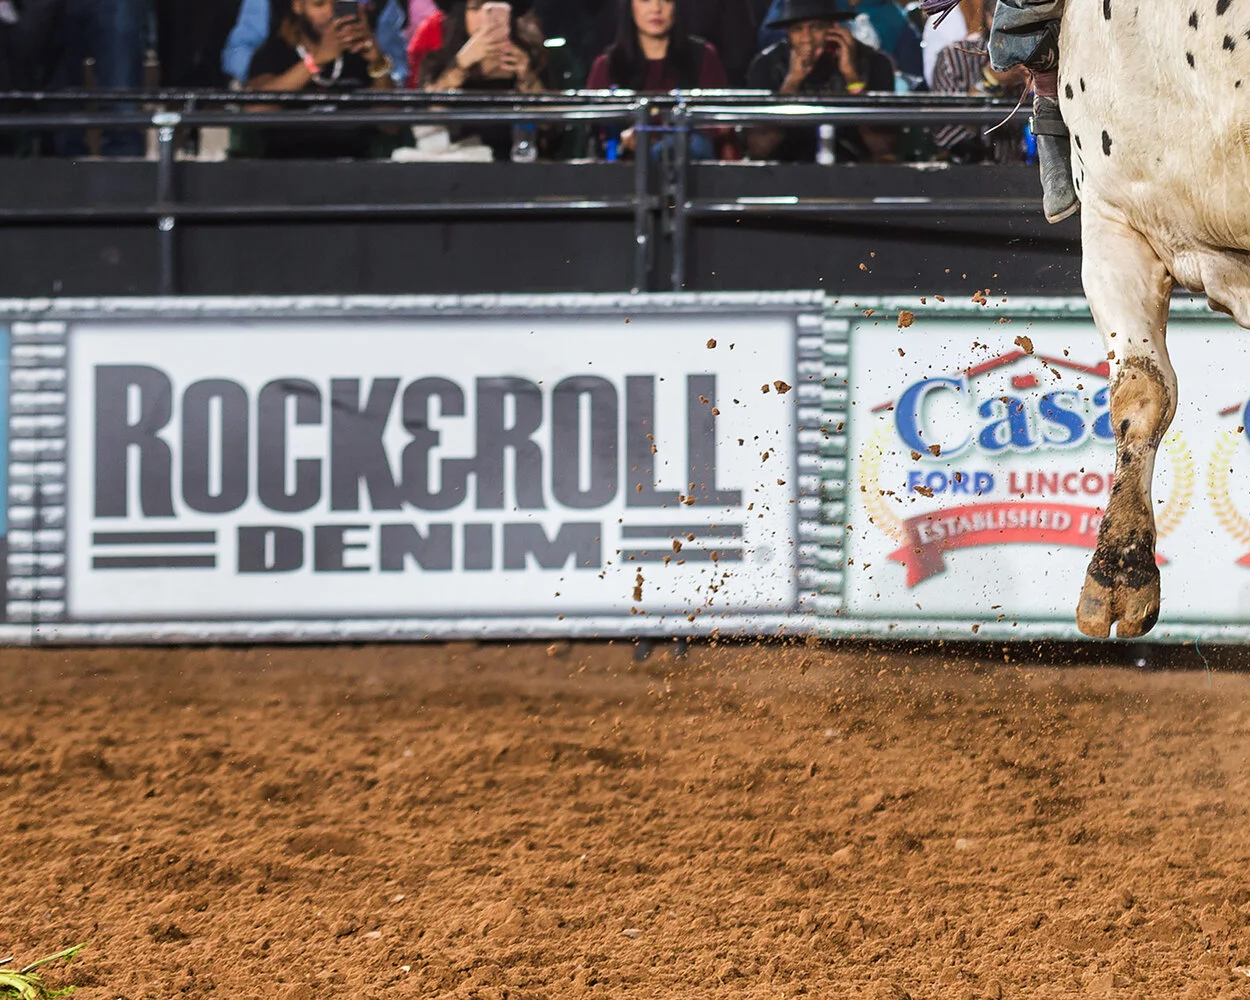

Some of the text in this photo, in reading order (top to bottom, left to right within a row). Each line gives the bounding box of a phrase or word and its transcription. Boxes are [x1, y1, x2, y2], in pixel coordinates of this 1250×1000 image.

[906, 470, 1116, 496] FORD LINCO
[916, 508, 1072, 544] ESTABLISHED
[237, 521, 604, 574] DENIM
